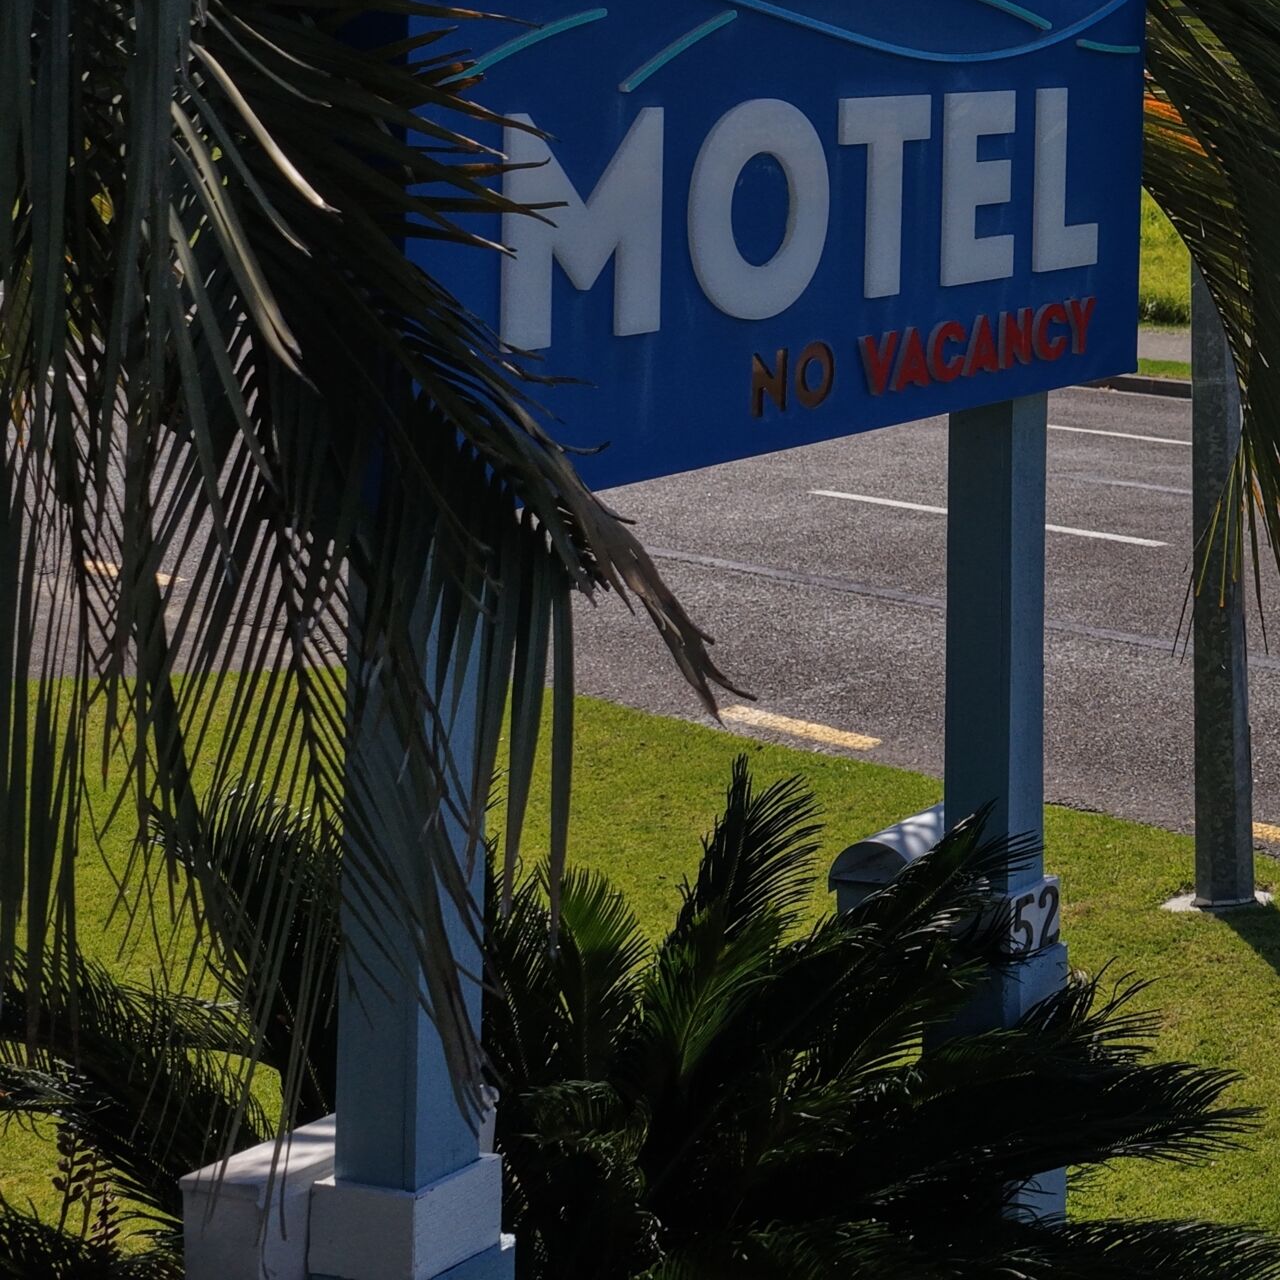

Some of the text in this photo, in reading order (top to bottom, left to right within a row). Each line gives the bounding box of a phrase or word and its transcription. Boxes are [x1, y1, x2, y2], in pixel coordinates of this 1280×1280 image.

[502, 88, 1098, 351] MOTEL
[752, 297, 1096, 417] NO VACANCY
[1014, 886, 1060, 958] 52
